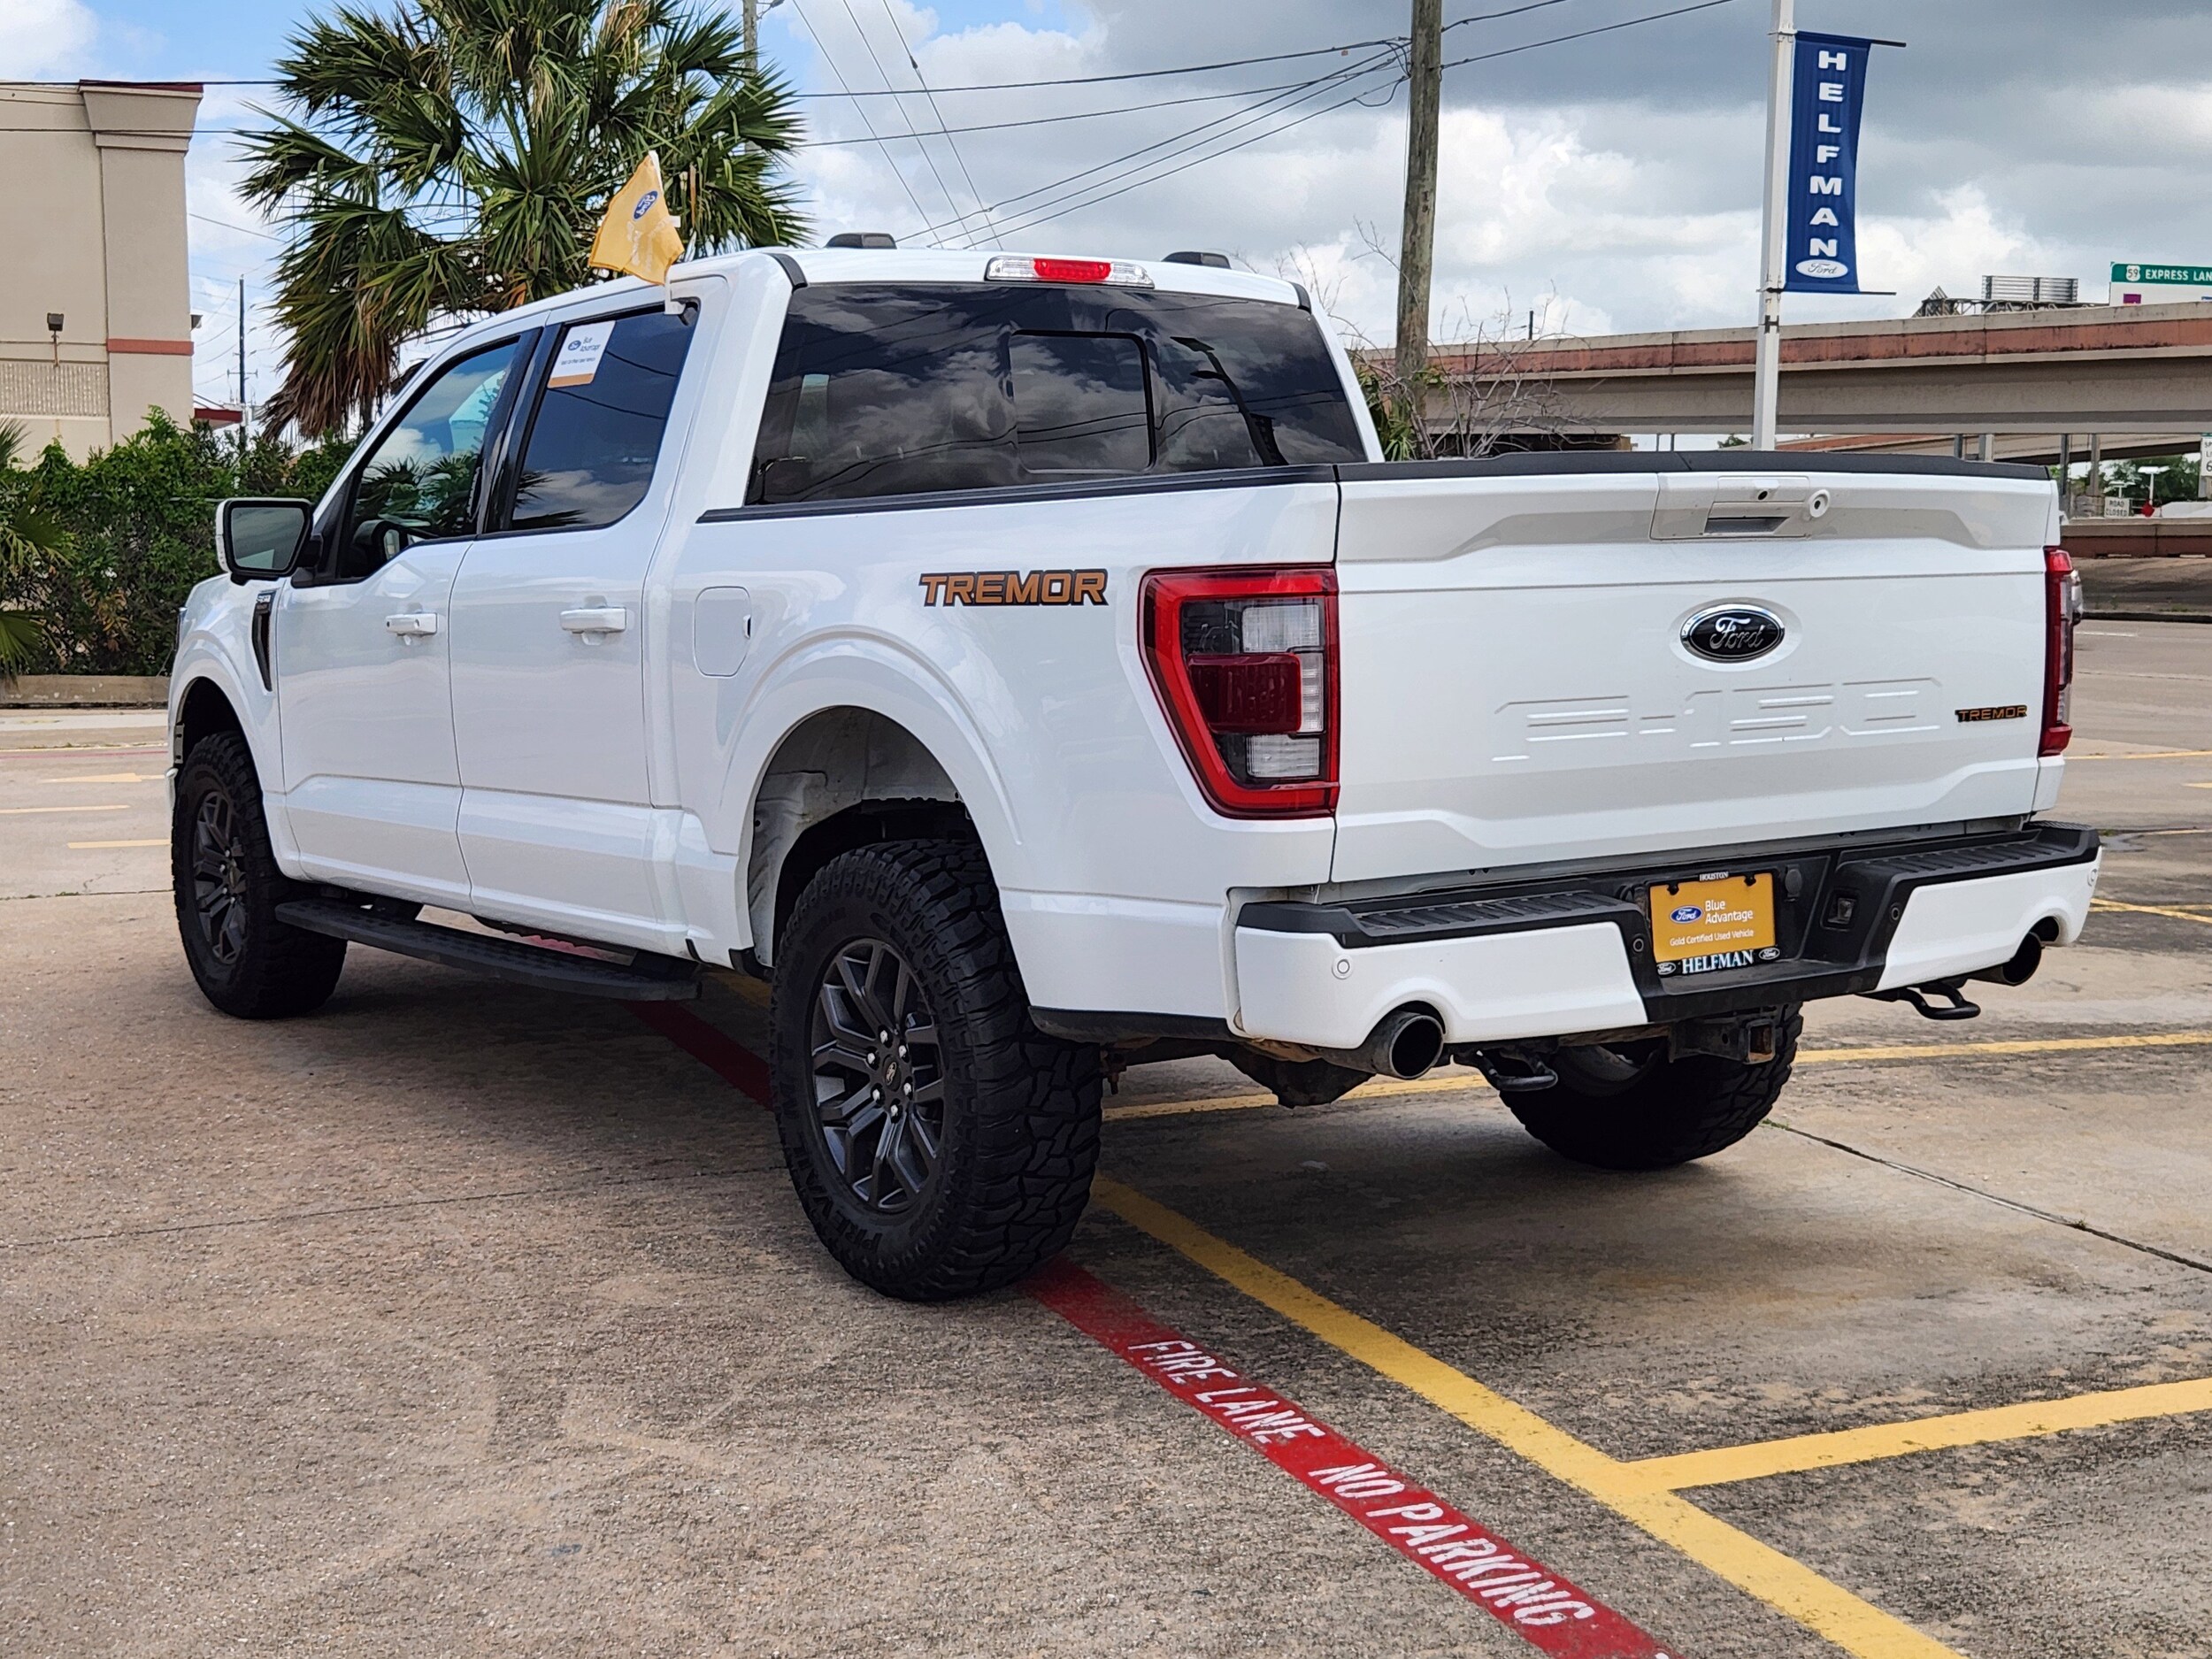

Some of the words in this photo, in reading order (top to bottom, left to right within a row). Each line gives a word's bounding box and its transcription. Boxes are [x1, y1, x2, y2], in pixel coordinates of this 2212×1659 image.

[1809, 50, 1847, 257] HELFMAN
[1807, 263, 1838, 275] Ford
[2127, 268, 2139, 278] 59
[2145, 268, 2189, 280] EXPRESS
[2105, 508, 2128, 517] CLOSED
[918, 569, 1109, 607] TREMOR
[1709, 617, 1765, 649] Ford
[1955, 705, 2027, 722] TREMOR
[1699, 871, 1729, 882] HOUSTON
[1705, 900, 1726, 911] Blue
[1705, 910, 1754, 925] Advantage
[1670, 936, 1686, 947] Gold
[1686, 933, 1714, 944] Certified
[1714, 932, 1731, 941] Used
[1732, 929, 1755, 940] Vehicle
[1681, 949, 1755, 974] HELFMAN
[1128, 1339, 1237, 1385] FIRE
[1195, 1386, 1326, 1444] LANE
[1308, 1463, 1406, 1499] NO
[1366, 1502, 1594, 1626] PARKING
